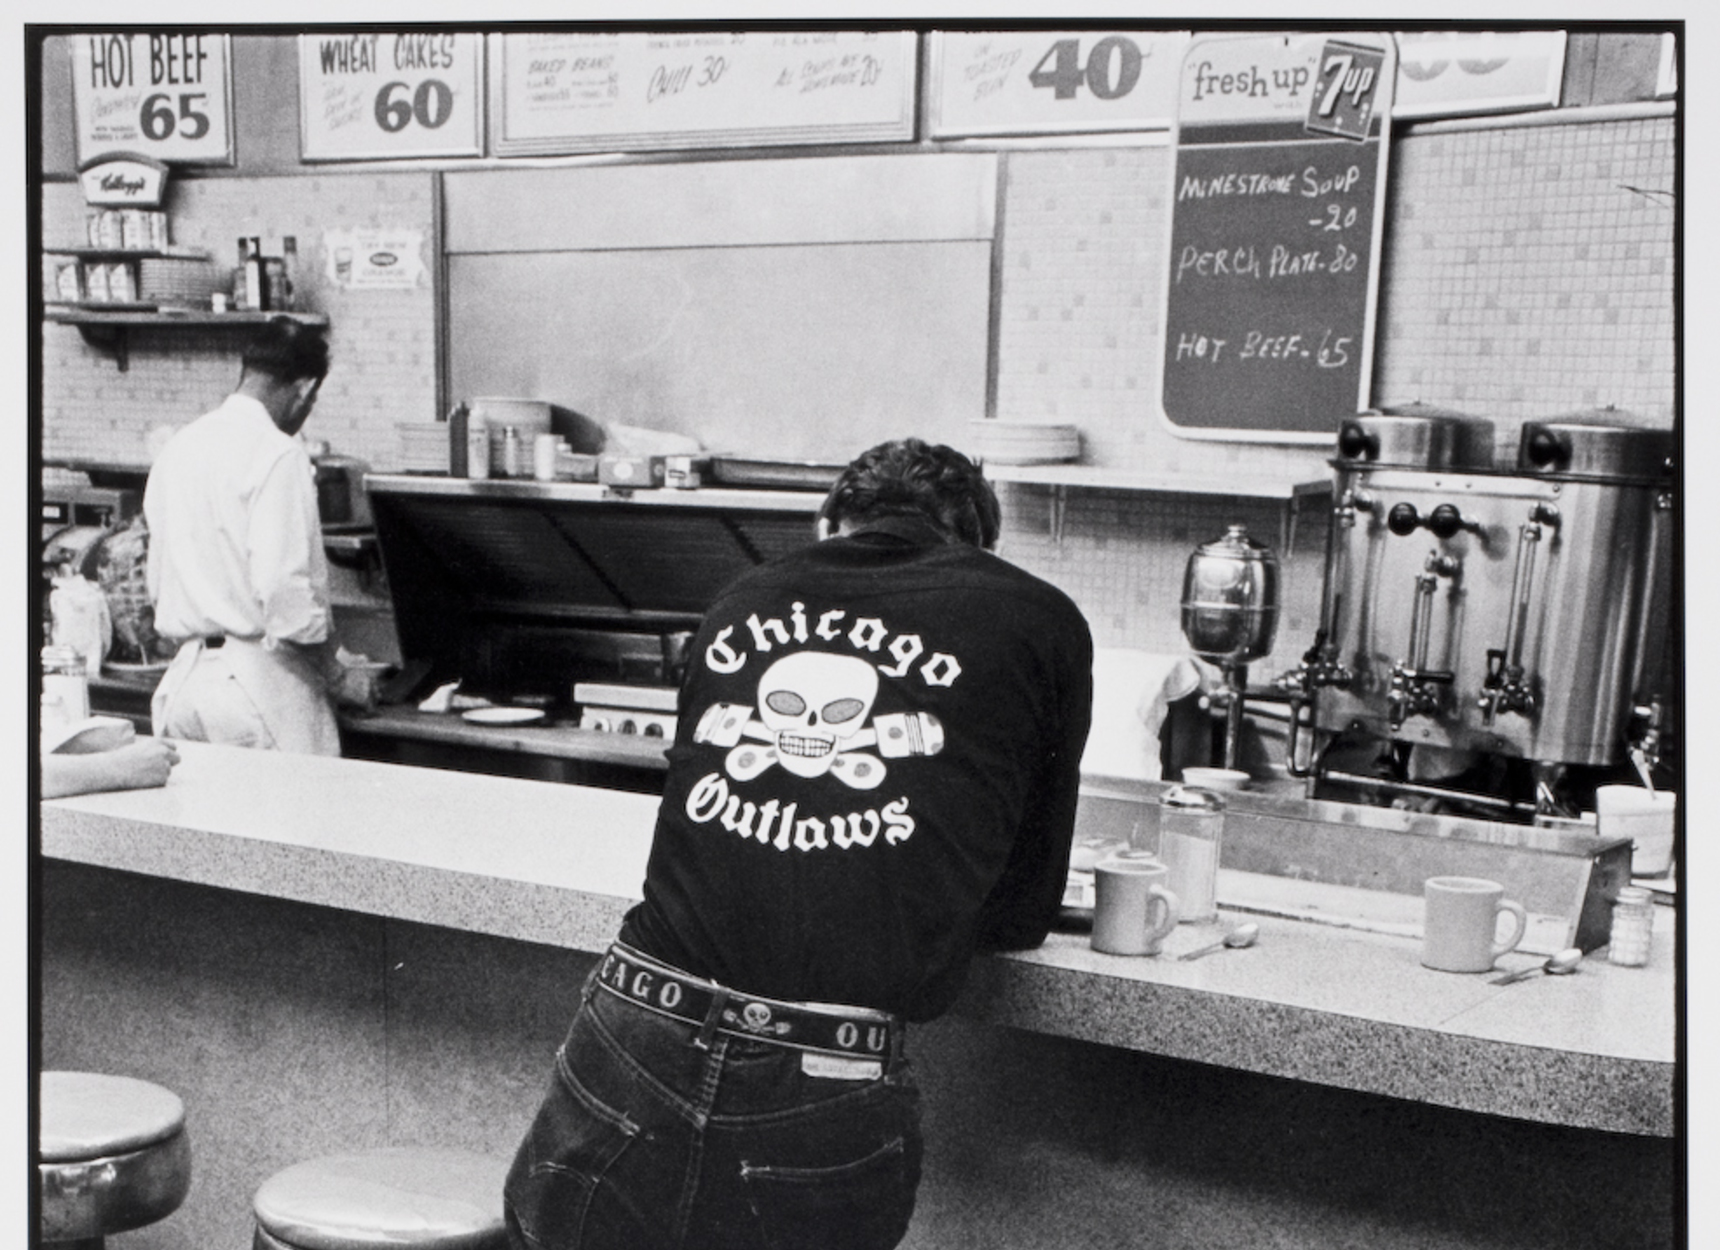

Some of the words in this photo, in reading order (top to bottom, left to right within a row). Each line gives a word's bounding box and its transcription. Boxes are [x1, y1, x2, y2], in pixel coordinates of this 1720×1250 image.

[90, 34, 134, 89] HOT
[150, 34, 207, 85] BEEF
[320, 34, 379, 75] WHEAT
[394, 33, 455, 70] CAKES
[1175, 332, 1227, 363] HOT
[705, 601, 962, 687] Chicago
[686, 772, 915, 852] Outlaws
